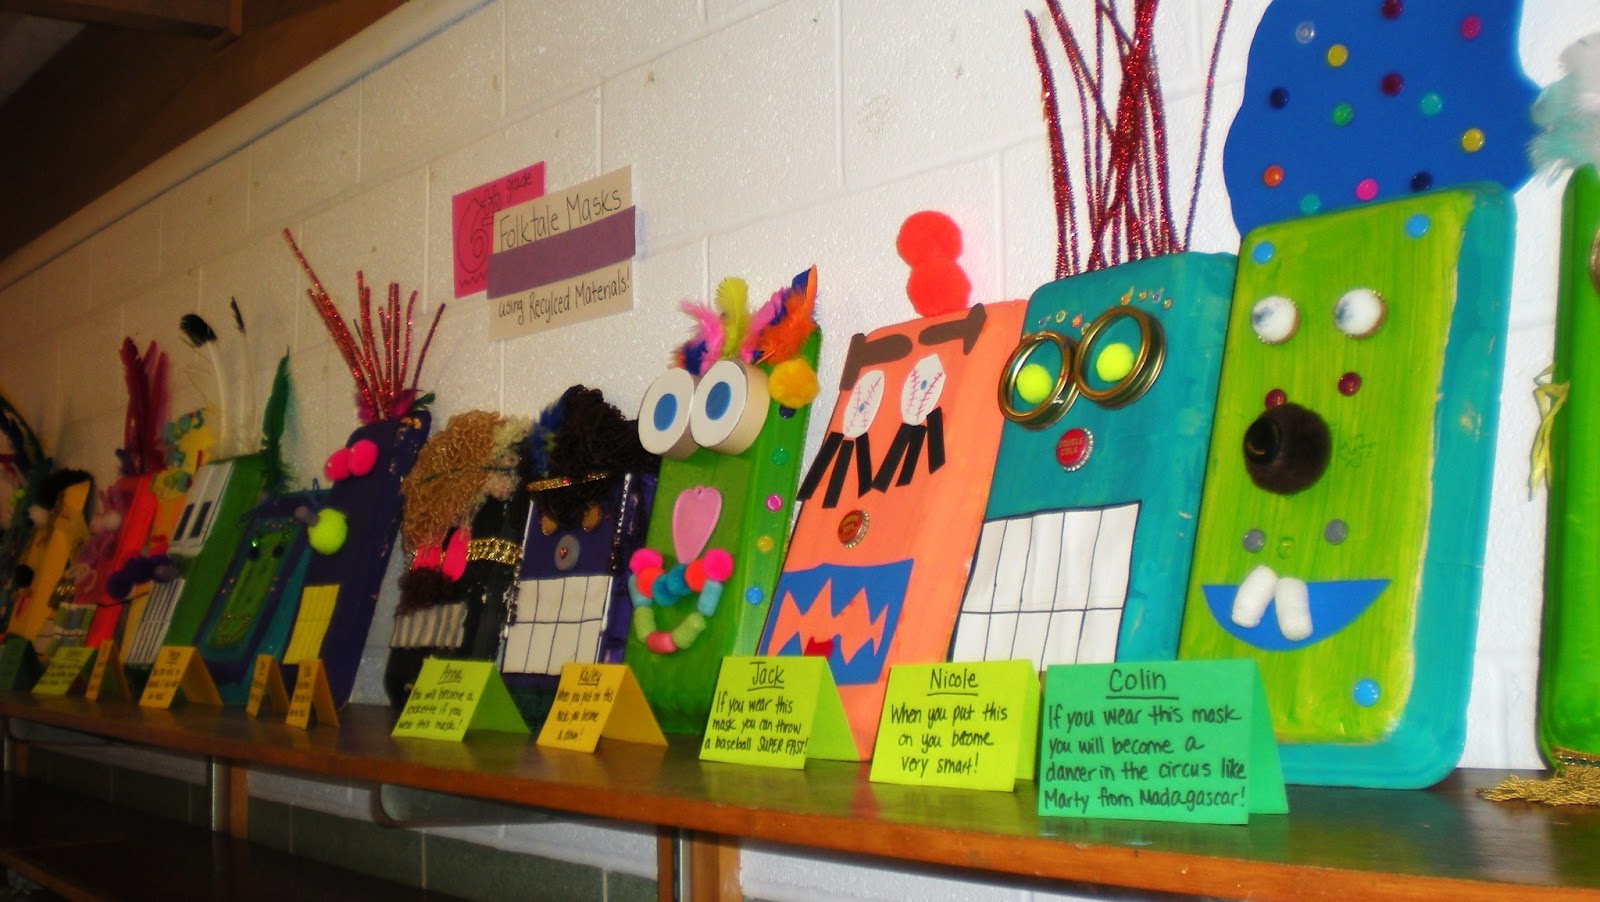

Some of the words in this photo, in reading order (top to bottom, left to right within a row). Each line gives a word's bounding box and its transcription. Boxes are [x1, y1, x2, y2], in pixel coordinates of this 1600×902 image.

[506, 172, 532, 204] grade
[500, 205, 559, 251] Folktale
[566, 189, 622, 230] Masks
[498, 298, 524, 326] using
[574, 267, 630, 309] Materials!
[749, 661, 784, 686] Jack
[930, 668, 979, 690] Nicole
[1109, 668, 1166, 693] Colin
[438, 688, 464, 701] become
[466, 693, 474, 702] a
[716, 690, 728, 713] If
[728, 698, 744, 716] you
[749, 698, 772, 713] wear
[775, 695, 793, 715] this
[441, 703, 449, 713] if
[448, 708, 463, 718] you
[891, 702, 922, 724] When
[927, 704, 948, 730] you
[952, 704, 975, 726] put
[982, 701, 1008, 722] this
[1048, 703, 1063, 730] If
[1067, 710, 1095, 734] you
[1103, 708, 1143, 726] wear
[1148, 705, 1184, 726] this
[1192, 705, 1242, 724] mask
[712, 718, 736, 732] mask
[742, 717, 756, 733] you
[759, 718, 772, 731] can
[775, 719, 802, 735] throw
[704, 736, 711, 749] a
[715, 736, 752, 751] baseball
[757, 736, 784, 755] SUPER
[785, 737, 809, 757] FAST!
[898, 733, 912, 747] on
[921, 734, 942, 754] you
[951, 730, 994, 748] become
[1049, 737, 1072, 760] you
[1078, 736, 1104, 755] will
[1111, 736, 1175, 755] become
[1184, 735, 1205, 751] a
[901, 756, 929, 779] very
[936, 752, 979, 775] smart!
[1045, 761, 1097, 782] dancer
[1099, 765, 1115, 781] in
[1121, 761, 1149, 781] the
[1158, 760, 1211, 779] circus
[1221, 757, 1247, 780] like
[1044, 788, 1090, 815] Marty
[1097, 786, 1134, 808] from
[1139, 786, 1246, 812] Madagascar!
